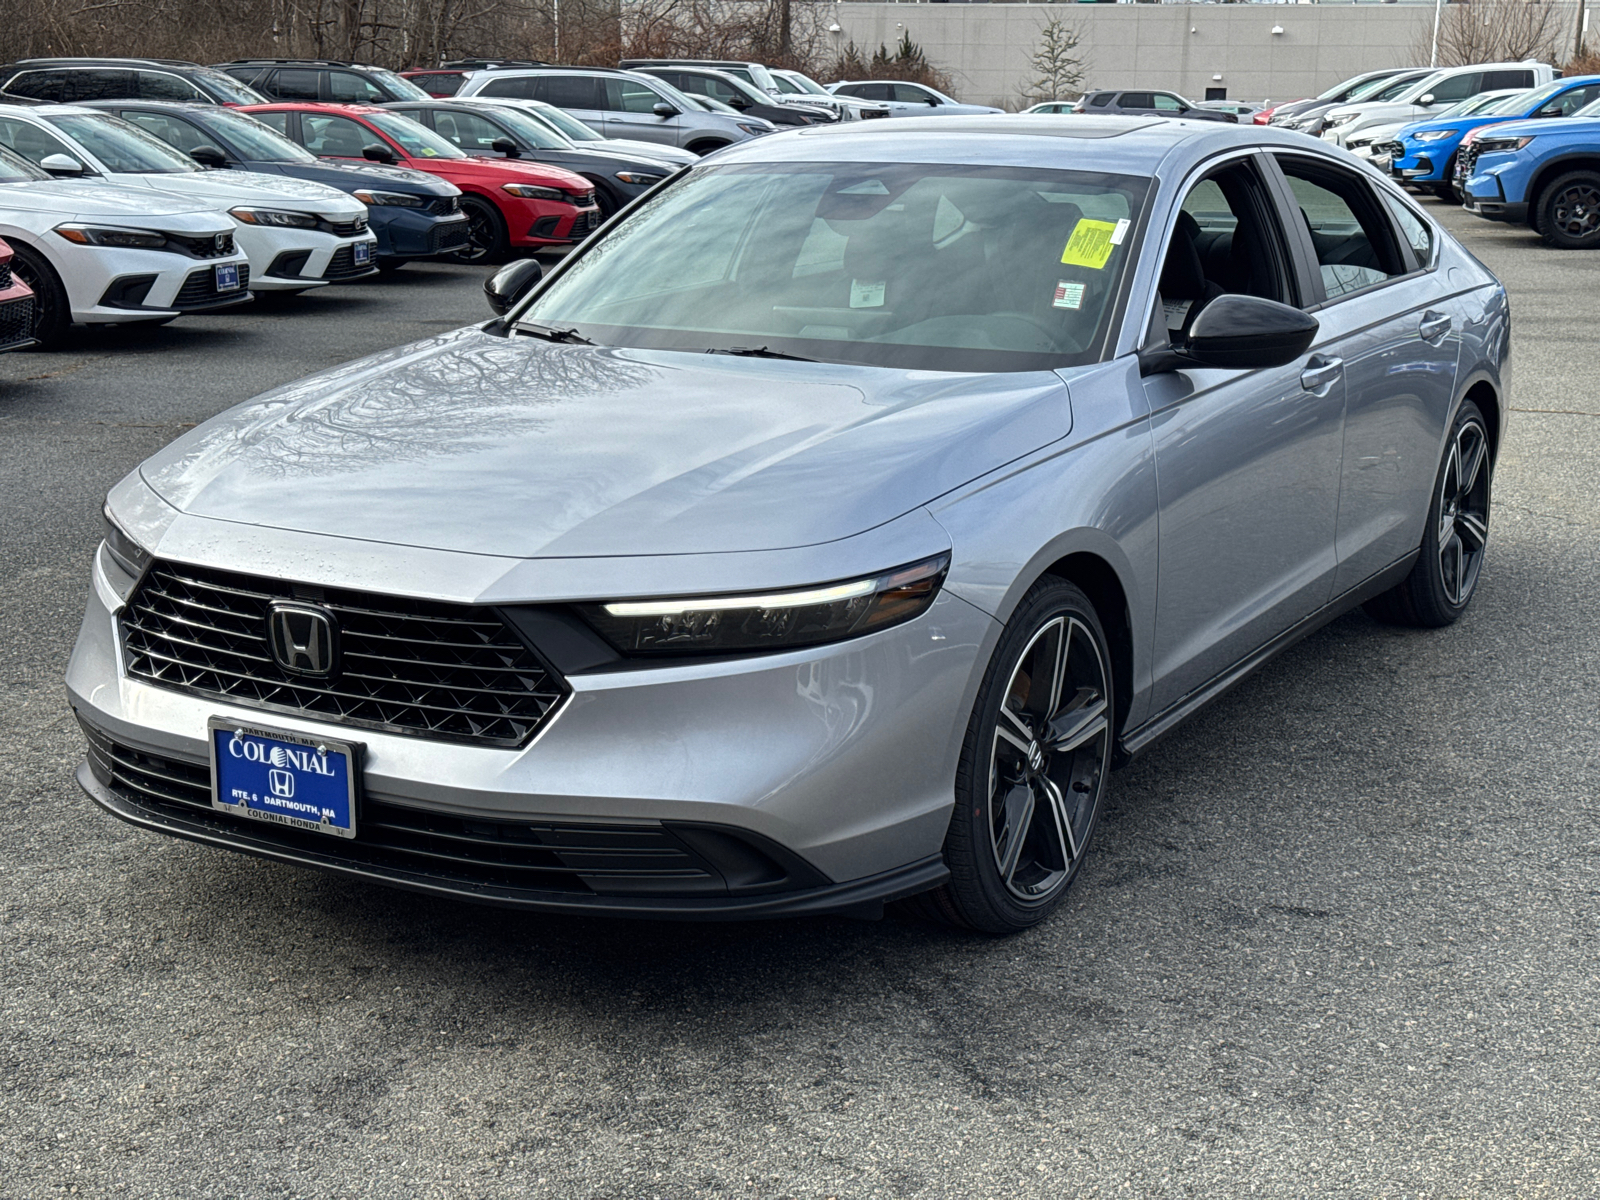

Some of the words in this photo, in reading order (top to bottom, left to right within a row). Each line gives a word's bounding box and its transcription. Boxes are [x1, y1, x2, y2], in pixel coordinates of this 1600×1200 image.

[302, 738, 315, 746] MA
[229, 739, 334, 776] COLONIAL
[232, 789, 251, 800] RTE.
[252, 794, 258, 802] 6
[264, 796, 320, 816] DARTMOUTH,
[322, 808, 336, 818] MA
[247, 809, 288, 824] COLONIAL
[291, 816, 321, 831] HONDA
